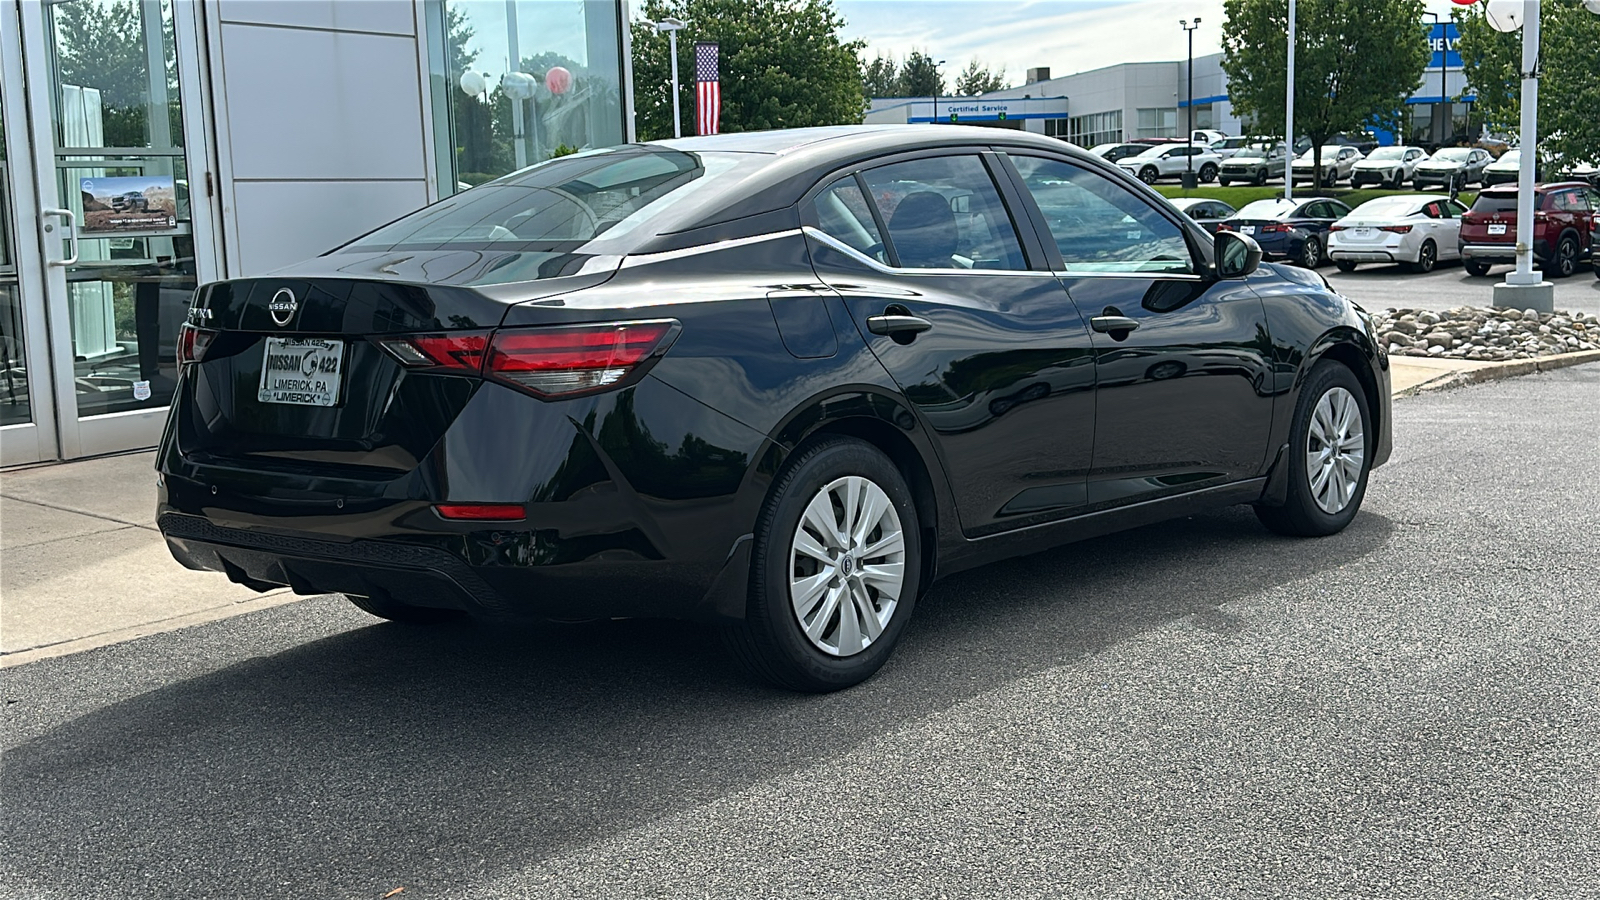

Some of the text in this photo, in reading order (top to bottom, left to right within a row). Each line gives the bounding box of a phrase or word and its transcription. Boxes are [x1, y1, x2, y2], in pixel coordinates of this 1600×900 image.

[269, 302, 298, 311] NISSAN
[269, 354, 338, 373] NISSAN 422
[274, 378, 327, 392] LIMERICK, PA
